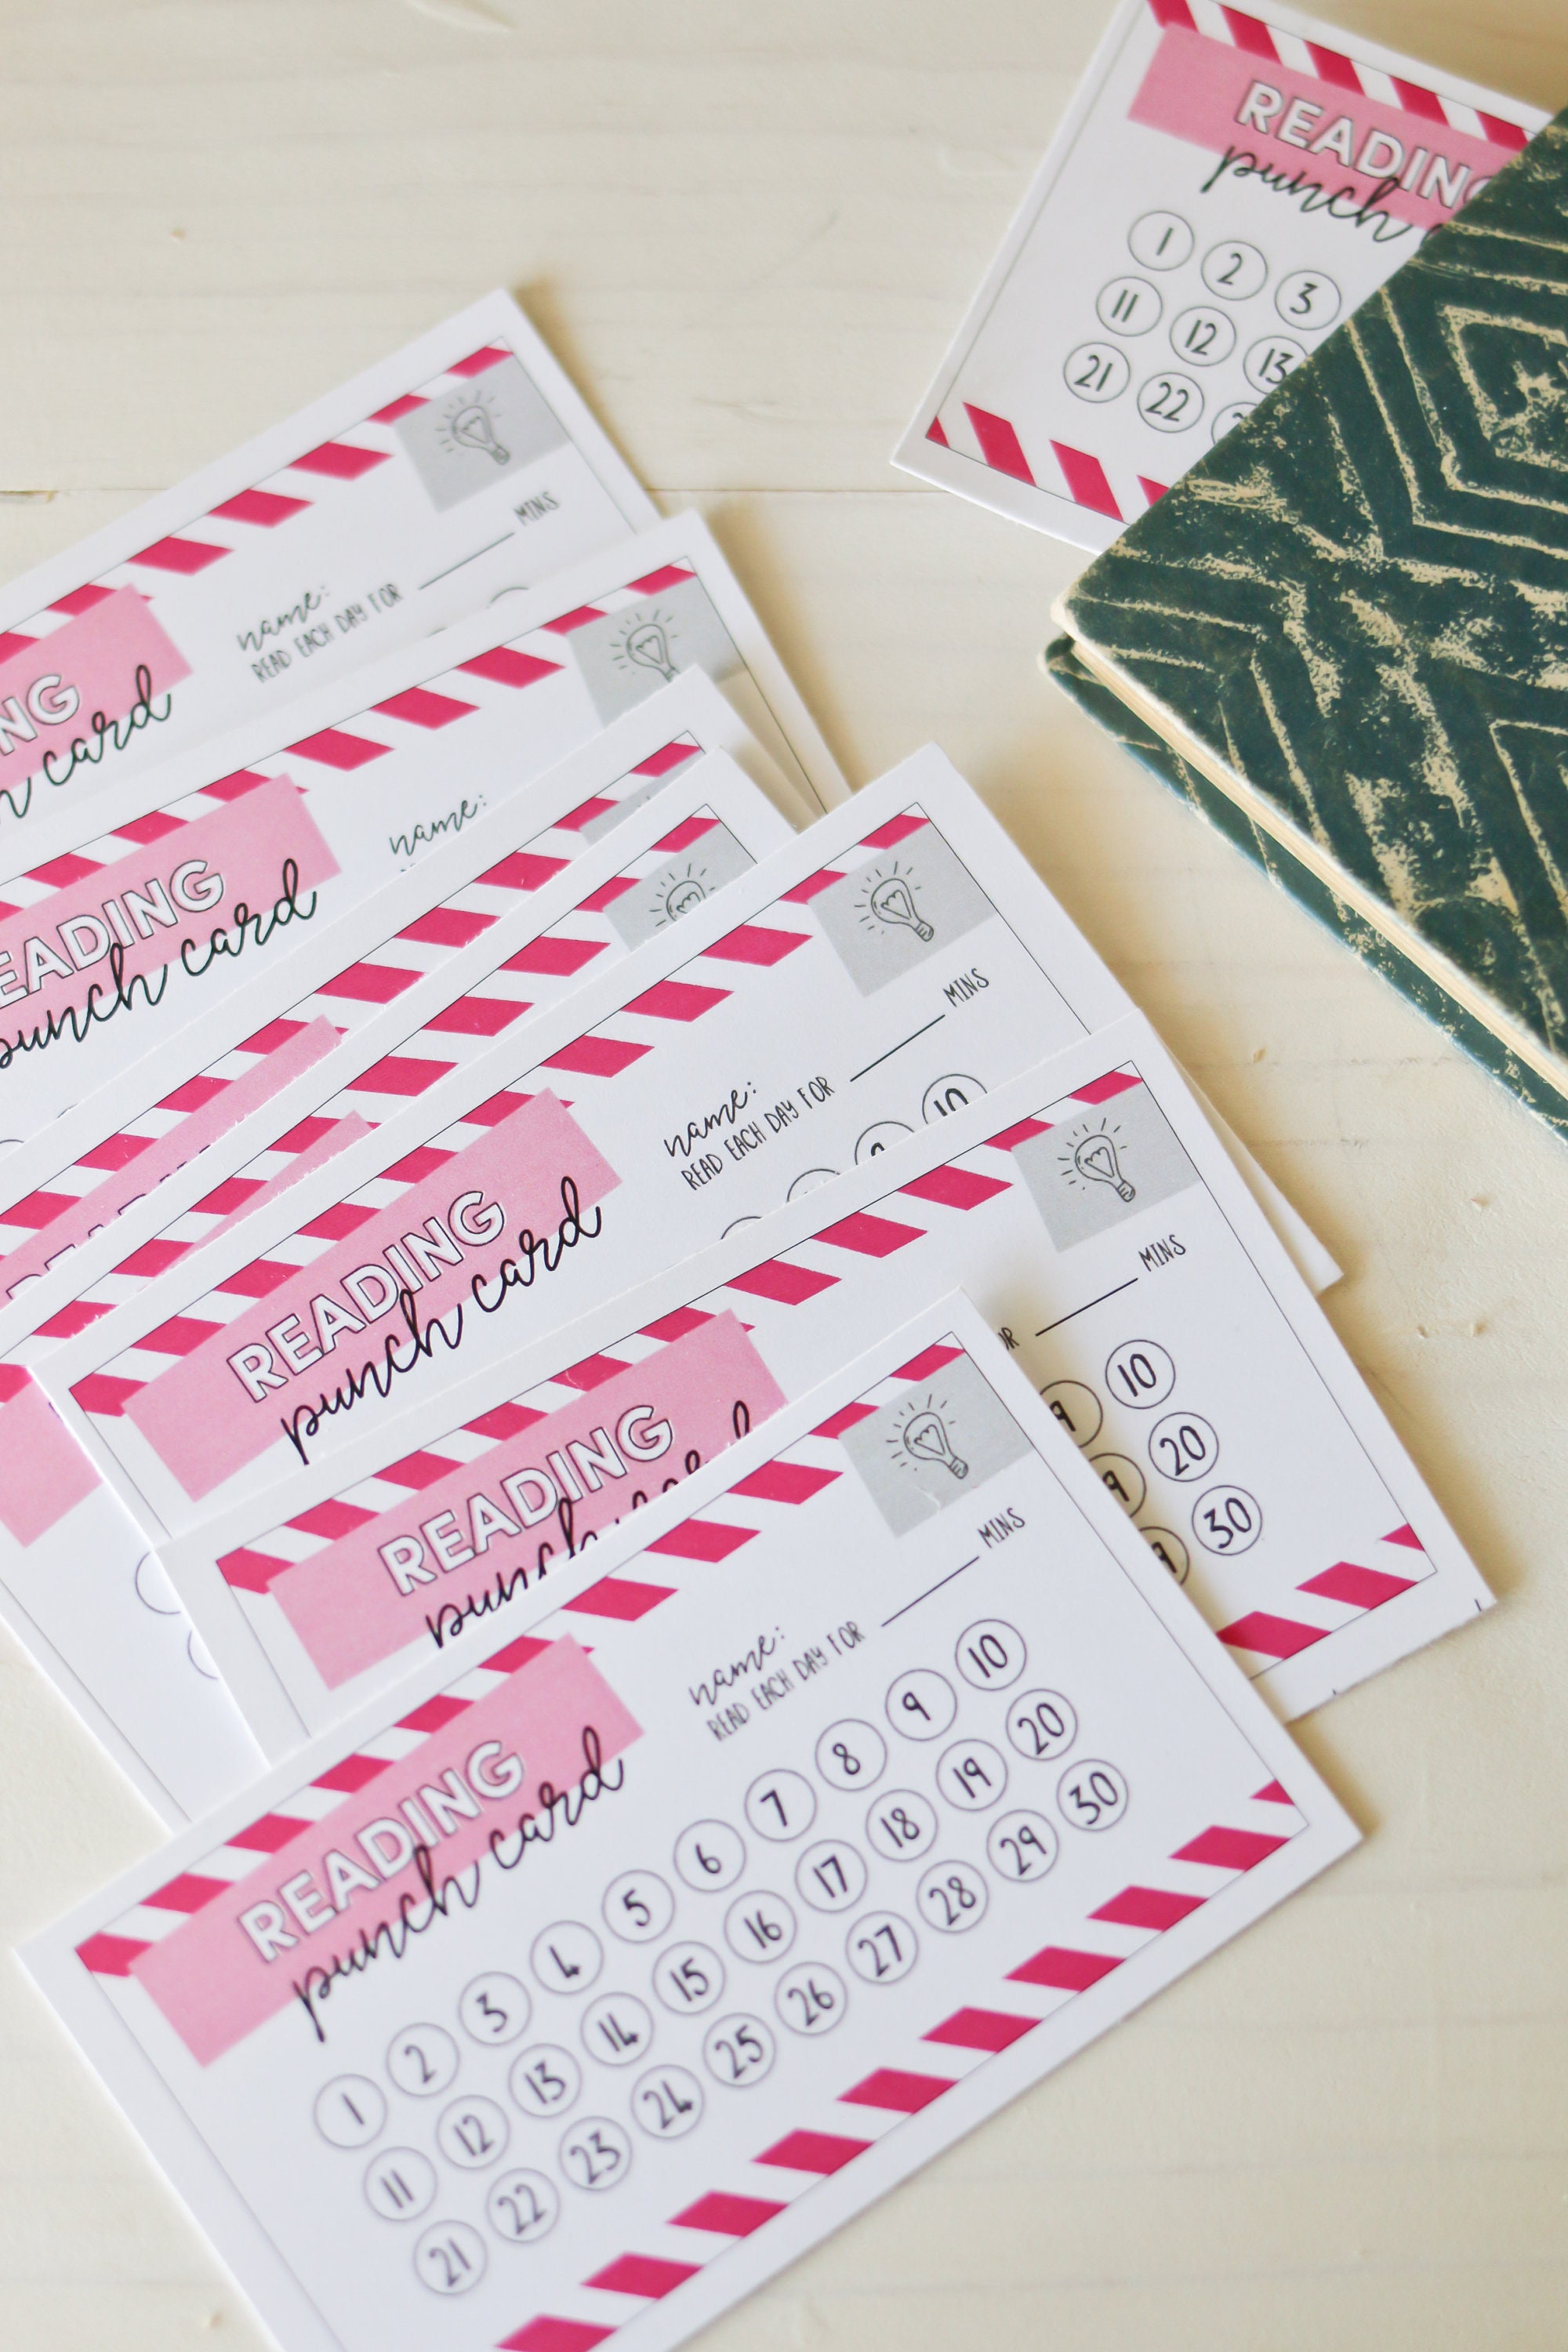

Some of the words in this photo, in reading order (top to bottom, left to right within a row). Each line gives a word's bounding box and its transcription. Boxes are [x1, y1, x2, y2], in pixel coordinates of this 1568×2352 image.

[1200, 144, 1414, 242] punch
[1111, 289, 1139, 322] 11
[1185, 319, 1218, 356] 12
[1258, 347, 1294, 385] 13
[1156, 227, 1174, 256] 1
[1217, 252, 1243, 285] 2
[1290, 282, 1318, 314] 3
[1073, 354, 1113, 392] 21
[1143, 381, 1189, 423] 22
[236, 585, 331, 652] name:
[250, 649, 292, 684] READ
[293, 626, 335, 659] EACH
[333, 603, 368, 635] DAY
[368, 583, 404, 613] FOR
[513, 490, 561, 527] MINS
[41, 664, 172, 787] card
[389, 794, 487, 856] name:
[0, 859, 224, 1009] EADING
[0, 942, 169, 1069] unch
[180, 858, 318, 977] card
[662, 1080, 758, 1158] name:
[680, 1152, 724, 1192] READ
[724, 1121, 768, 1161] EACH
[763, 1100, 800, 1134] DAY
[796, 1076, 835, 1109] FOR
[942, 967, 990, 1007] MINS
[226, 1190, 505, 1404] READING
[280, 1287, 464, 1466] punch
[470, 1176, 602, 1313] card
[1138, 1234, 1186, 1272] MINS
[1050, 1400, 1076, 1432] 9
[1116, 1353, 1157, 1398] 10
[376, 1403, 674, 1597] READING
[1102, 1469, 1130, 1502] 9
[1157, 1425, 1207, 1478] 20
[1151, 1541, 1178, 1573] 9
[1202, 1496, 1254, 1551] 30
[687, 1626, 787, 1708] name:
[707, 1702, 749, 1743] READ
[757, 1671, 794, 1714] EACH
[793, 1645, 830, 1683] DAY
[829, 1619, 866, 1657] FOR
[976, 1504, 1027, 1551] MINS
[238, 1739, 526, 1964] READING
[292, 1843, 481, 2043] punch
[488, 1726, 624, 1871] card
[342, 2092, 365, 2125] 1
[403, 2043, 435, 2084] 2
[476, 1991, 508, 2033] 3
[550, 1945, 580, 1979] 4
[622, 1888, 650, 1927] 5
[695, 1842, 721, 1875] 6
[760, 1788, 788, 1827] 7
[832, 1740, 861, 1776] 8
[902, 1690, 931, 1721] 9
[963, 1628, 1008, 1679] 10
[380, 2169, 414, 2209] 11
[454, 2113, 494, 2157] 12
[524, 2060, 566, 2104] 13
[598, 2013, 639, 2052] 14
[670, 1957, 709, 2002] 15
[744, 1910, 782, 1949] 16
[813, 1853, 848, 1898] 17
[880, 1806, 920, 1849] 18
[953, 1755, 992, 1799] 19
[1017, 1700, 1065, 1755] 20
[428, 2238, 471, 2288] 21
[496, 2182, 545, 2236] 22
[569, 2129, 621, 2185] 23
[643, 2081, 693, 2129] 24
[714, 2024, 763, 2079] 25
[787, 1978, 834, 2027] 26
[857, 1922, 902, 1977] 27
[928, 1875, 977, 1926] 28
[1000, 1824, 1047, 1876] 29
[1069, 1769, 1118, 1825] 30
